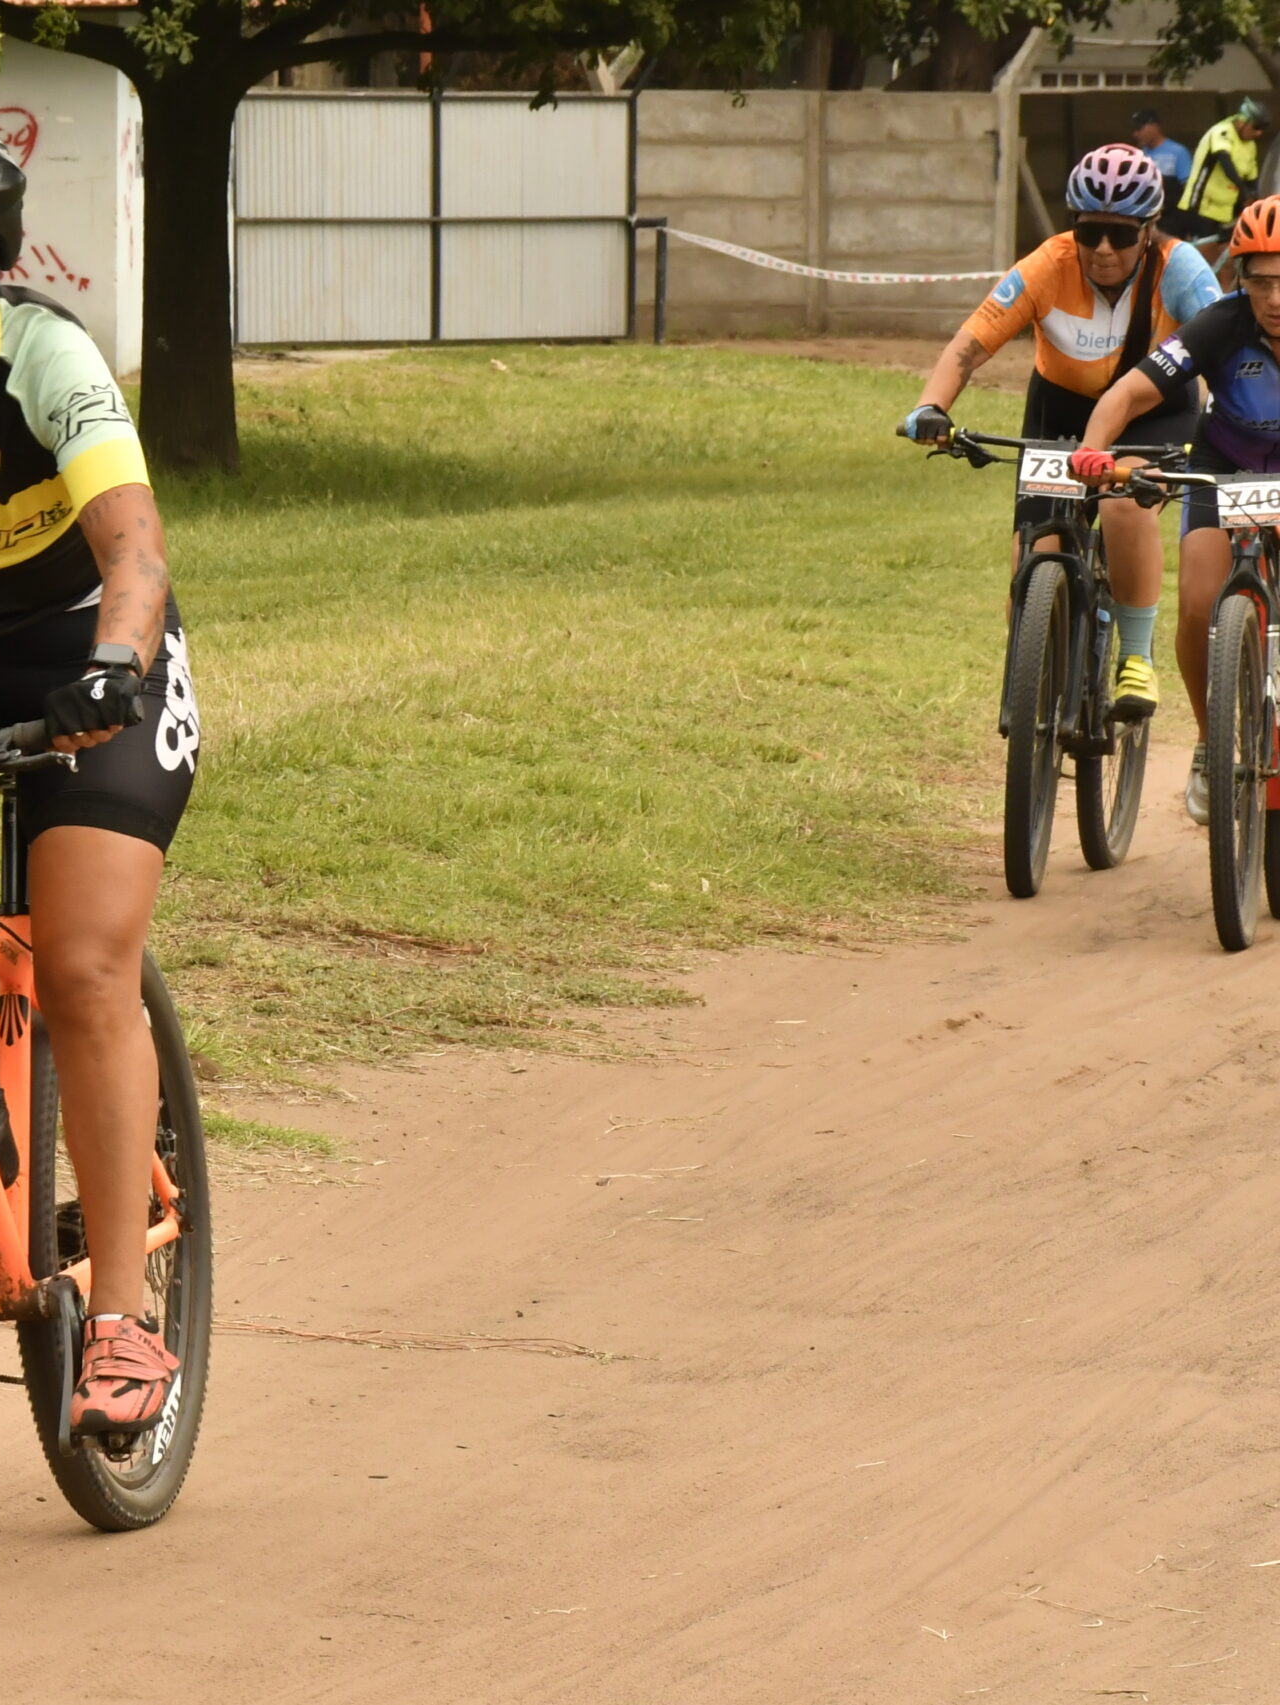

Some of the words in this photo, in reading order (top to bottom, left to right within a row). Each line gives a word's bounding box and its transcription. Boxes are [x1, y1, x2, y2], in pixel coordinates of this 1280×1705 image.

[1148, 350, 1177, 377] KAITO
[1029, 457, 1063, 479] 73
[1227, 488, 1280, 511] 740
